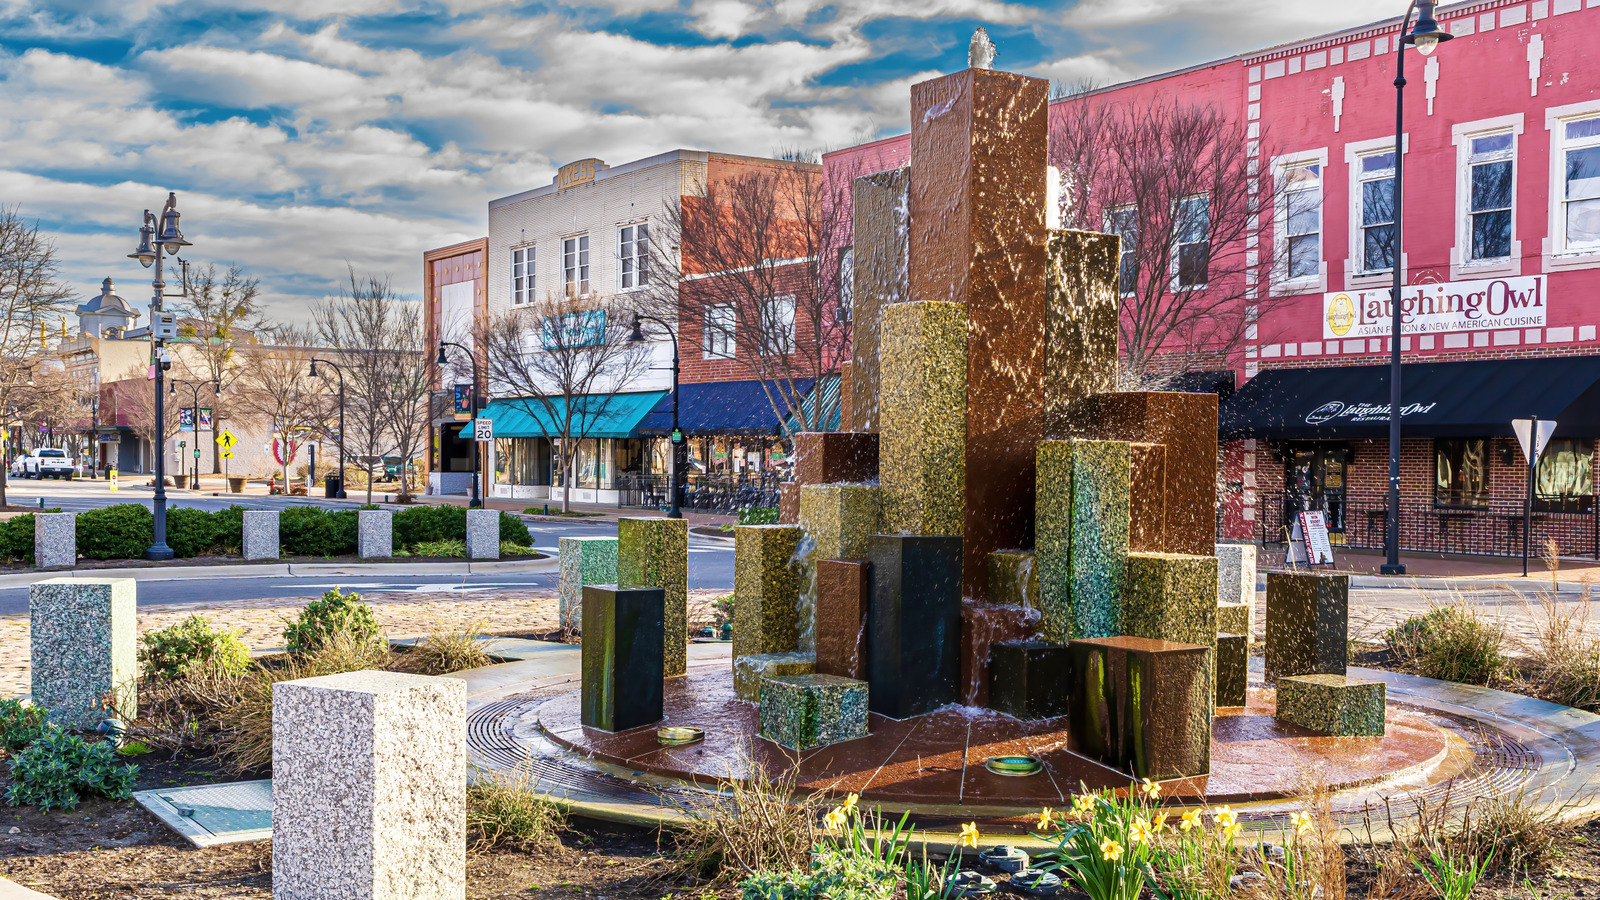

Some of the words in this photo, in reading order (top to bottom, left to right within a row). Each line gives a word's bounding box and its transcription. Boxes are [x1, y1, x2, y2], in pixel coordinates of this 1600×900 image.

[558, 160, 595, 188] KRESS
[1358, 326, 1384, 335] ASIAN
[1385, 324, 1418, 334] FION
[1420, 323, 1427, 331] &
[1429, 322, 1450, 331] NEW
[1451, 318, 1501, 329] AMERICAN
[1503, 315, 1543, 326] CUISINE
[477, 430, 492, 439] 20
